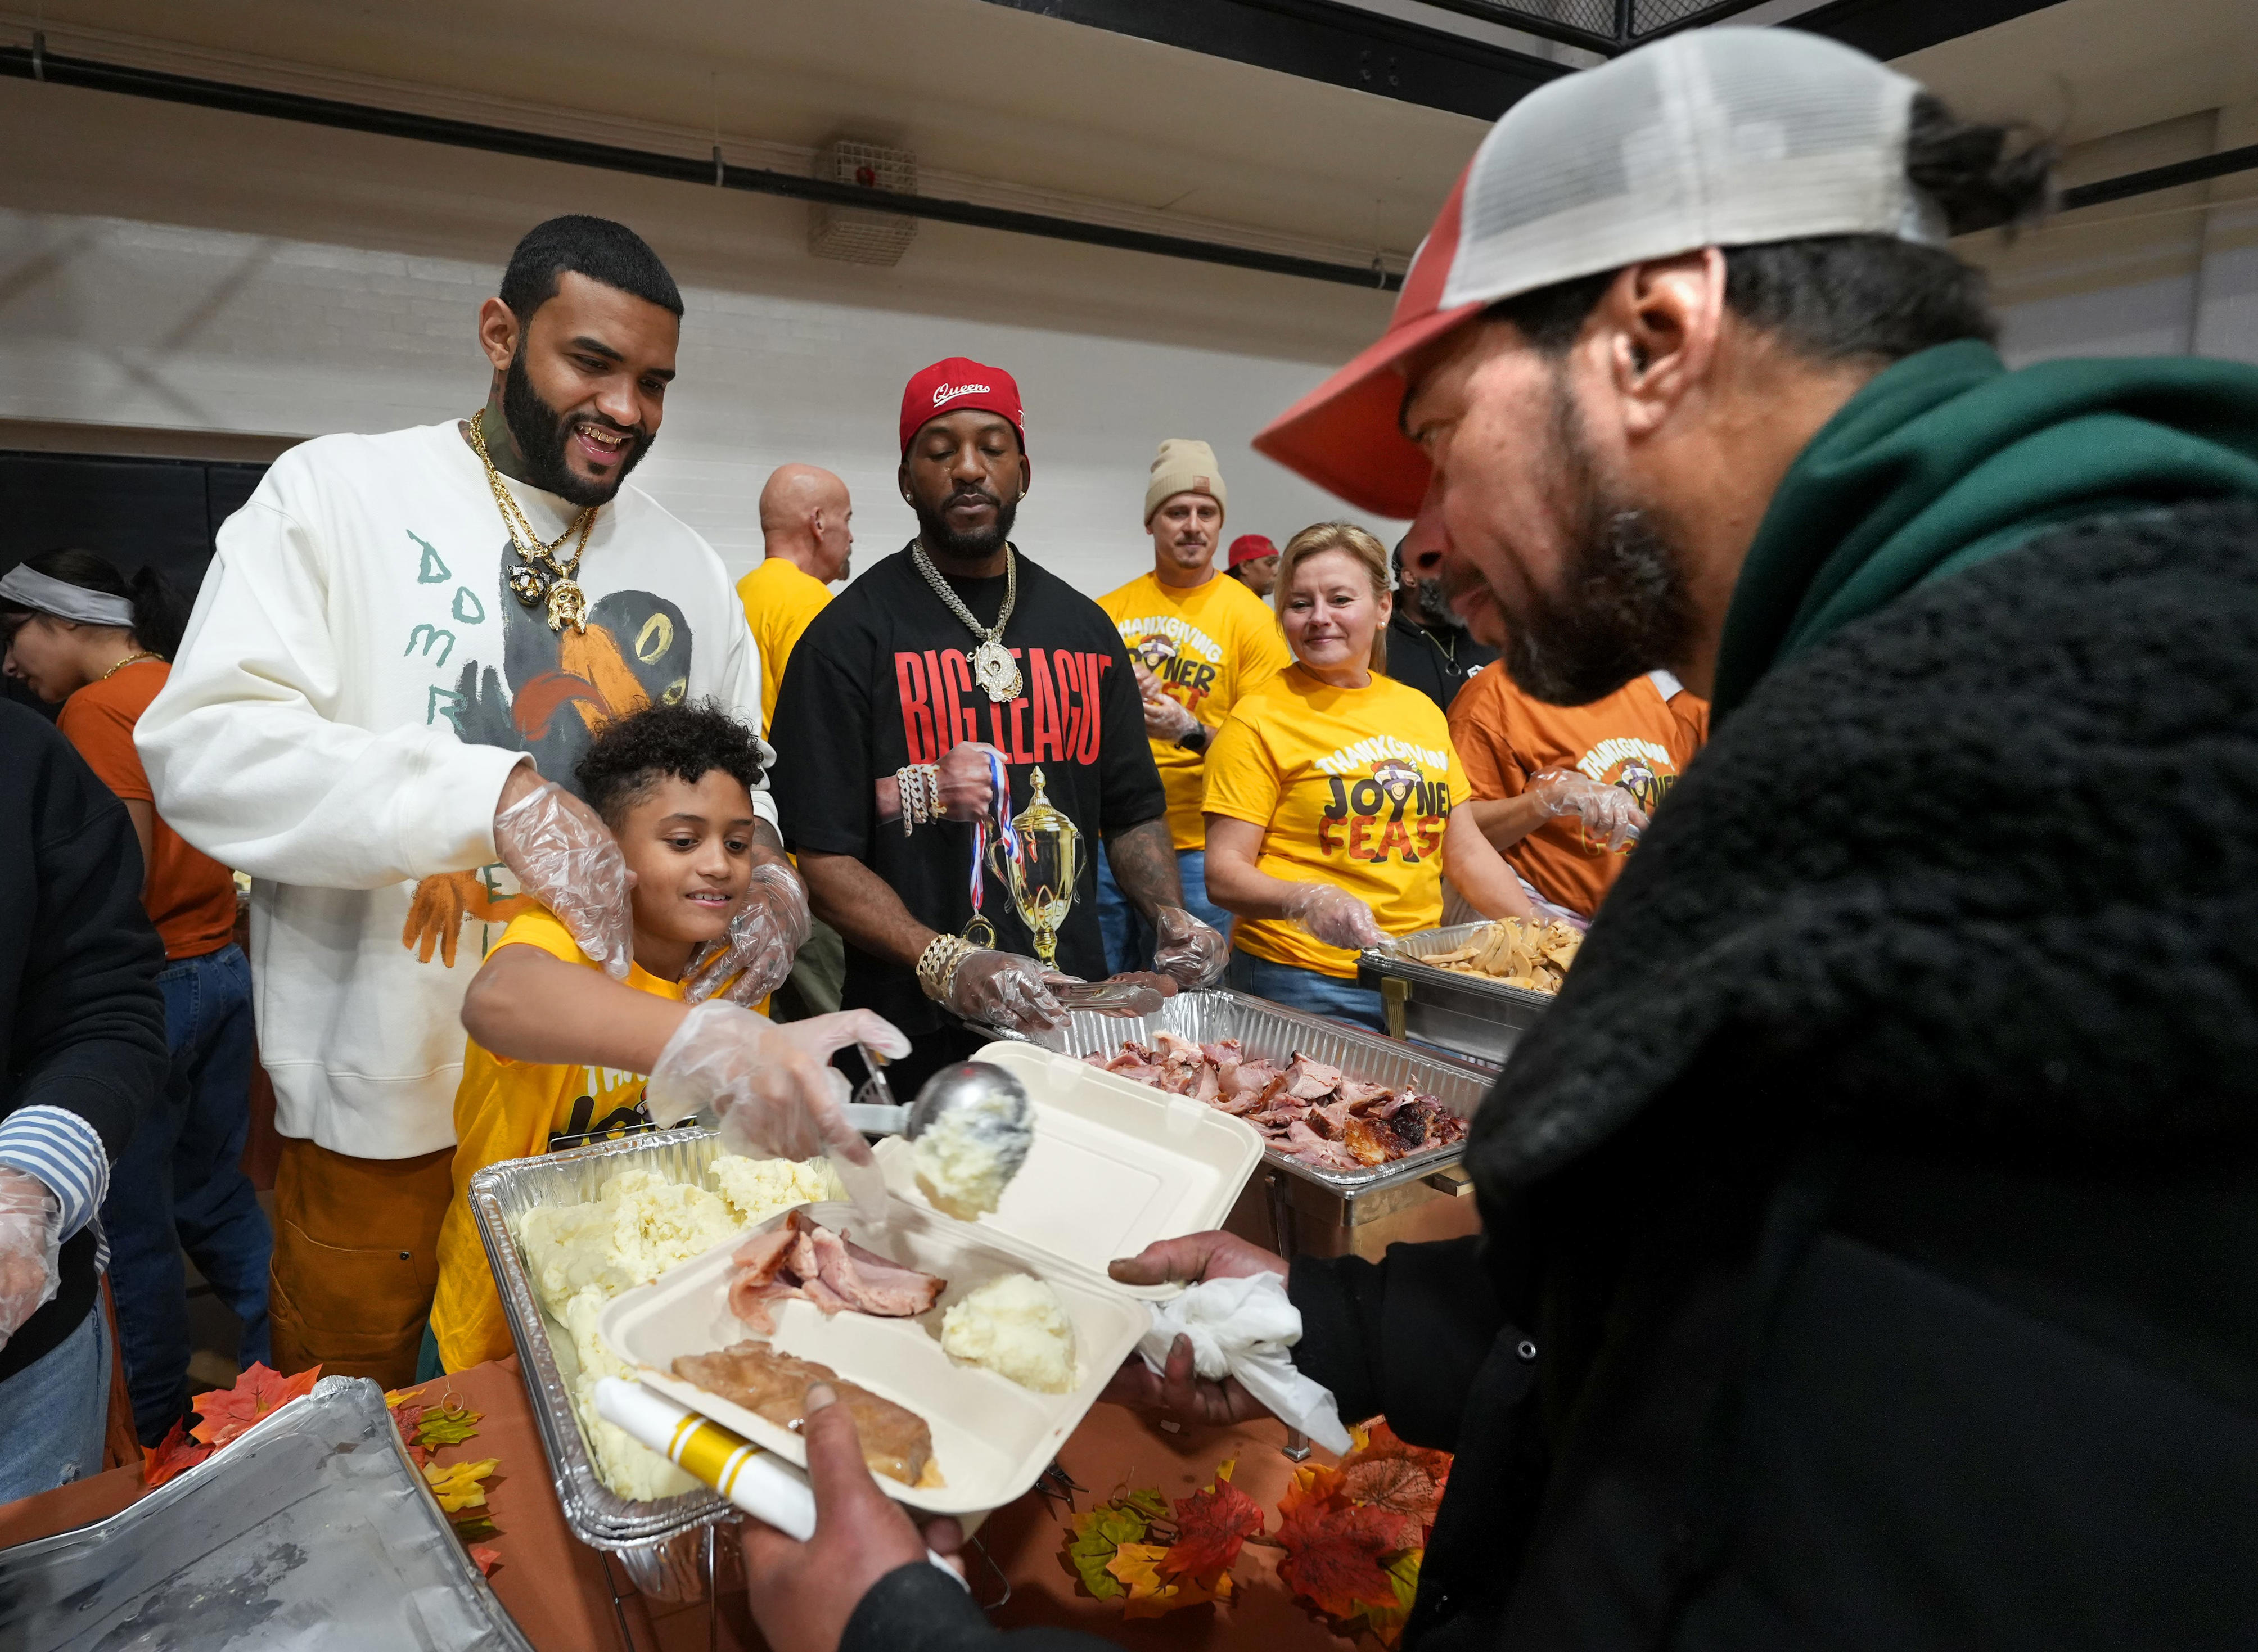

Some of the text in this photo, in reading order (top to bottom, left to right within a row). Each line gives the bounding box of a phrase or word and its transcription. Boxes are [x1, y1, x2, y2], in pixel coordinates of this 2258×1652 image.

[933, 383, 990, 407] Queens
[1118, 616, 1223, 663] HANXGIVING
[894, 648, 1112, 765] BIG LEAGU
[1314, 735, 1449, 775] THANXGIVIN
[1576, 737, 1675, 782] THANXGIVIN
[1324, 777, 1453, 822] JOYNE
[1318, 814, 1449, 863] FEAS
